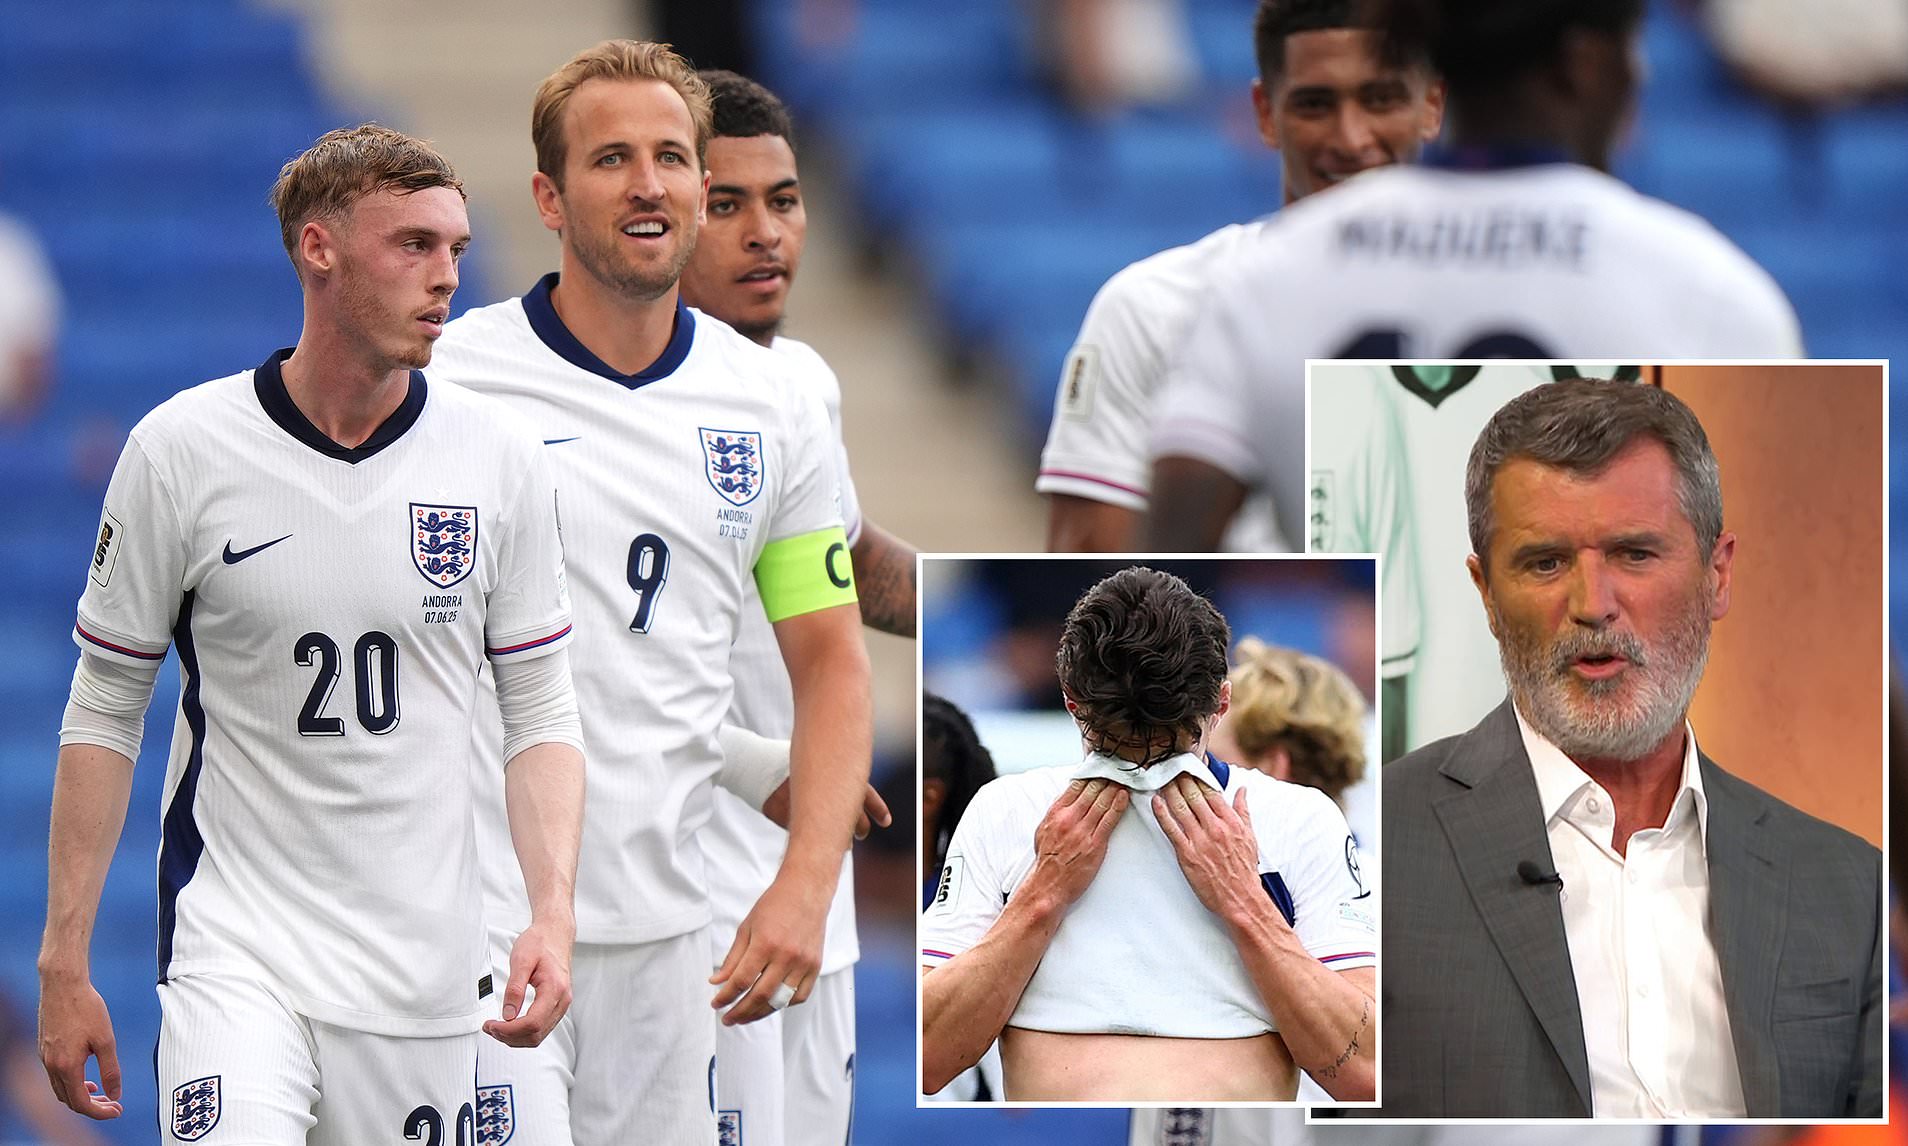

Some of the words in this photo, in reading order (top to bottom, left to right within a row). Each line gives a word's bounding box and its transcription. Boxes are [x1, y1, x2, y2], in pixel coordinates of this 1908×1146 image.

[717, 508, 753, 525] ANDORRA
[825, 542, 851, 589] C
[626, 533, 671, 634] 9
[422, 595, 463, 608] ANDORRA
[424, 610, 458, 624] 07.06.25
[294, 631, 401, 736] 20
